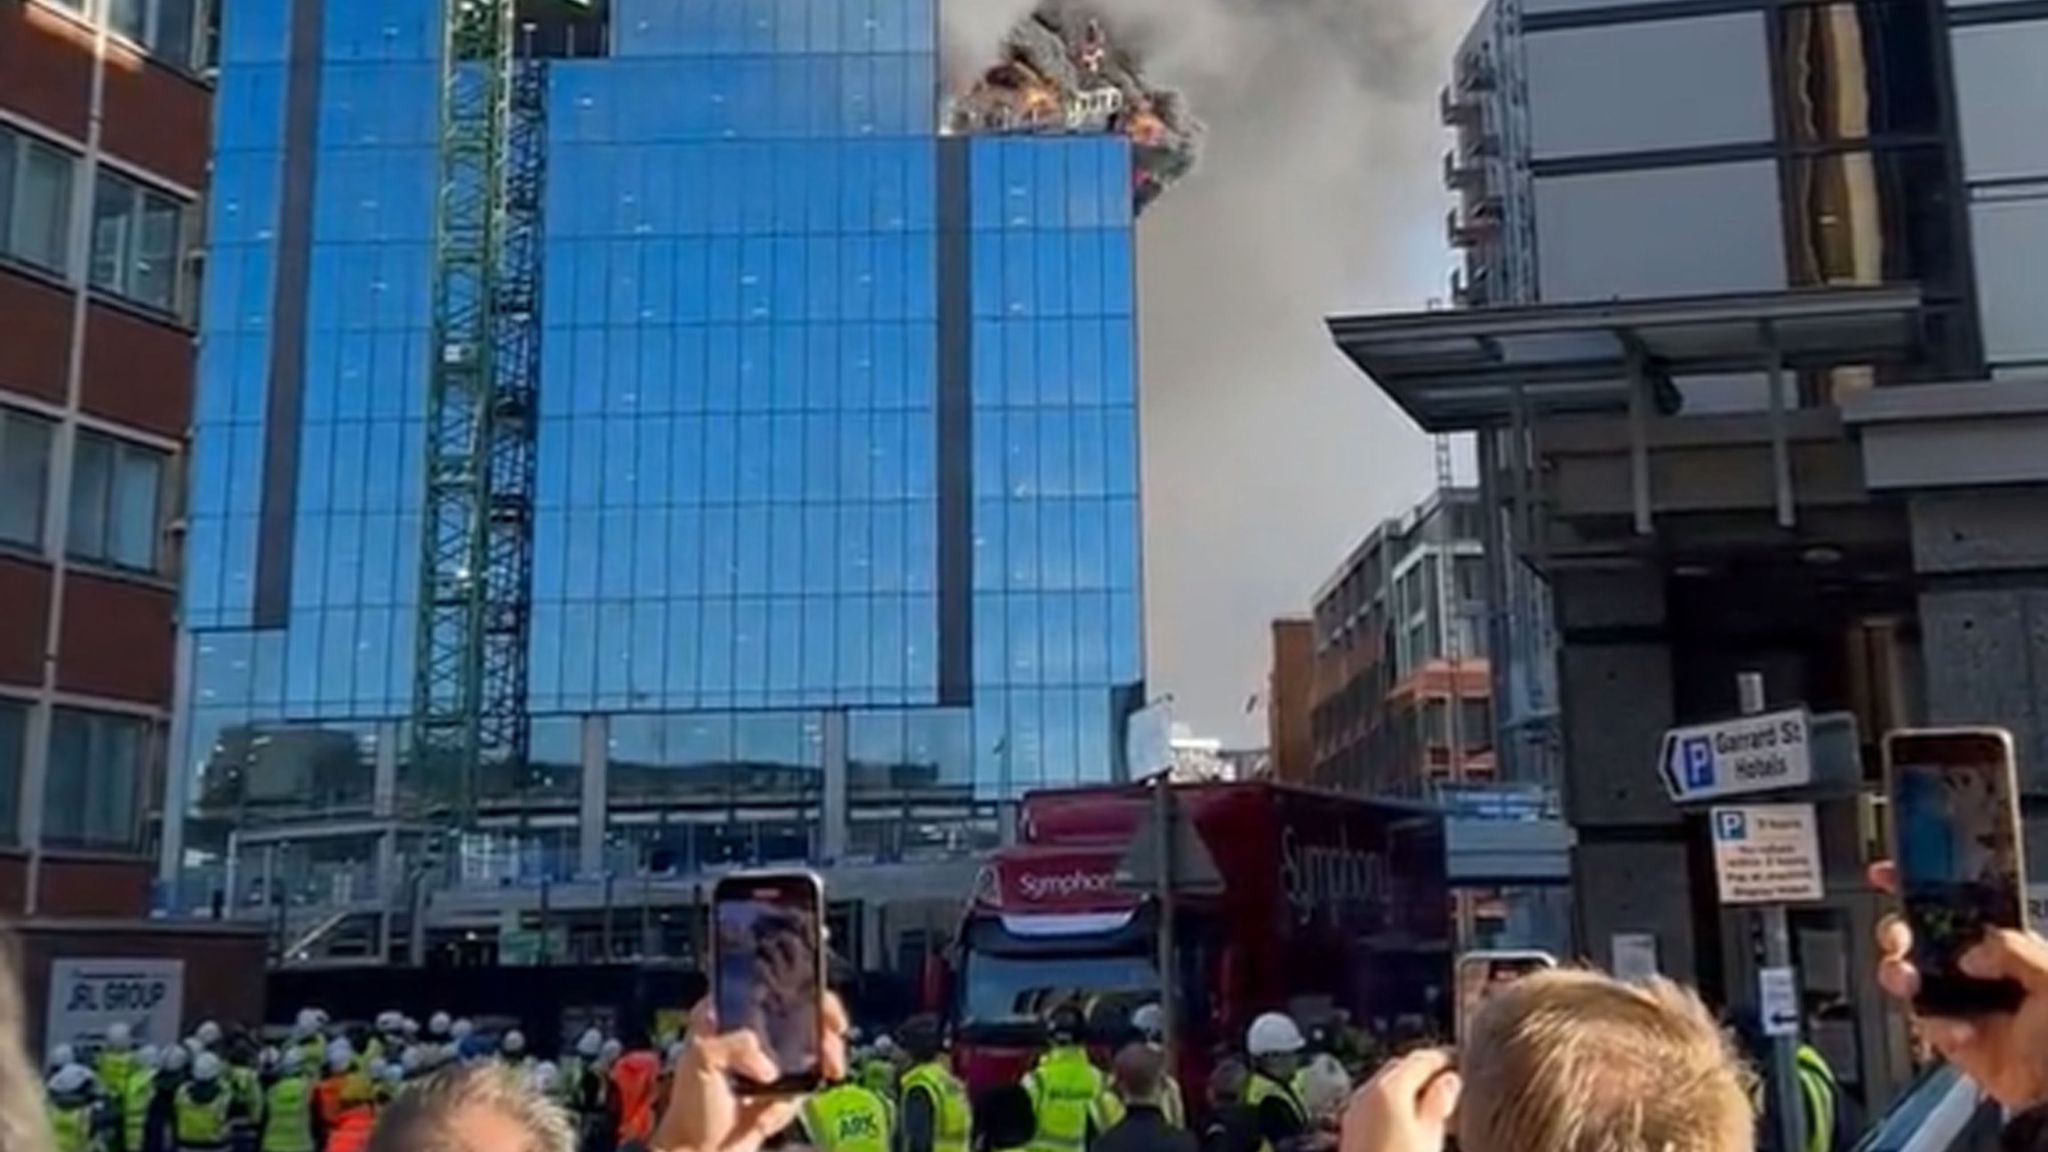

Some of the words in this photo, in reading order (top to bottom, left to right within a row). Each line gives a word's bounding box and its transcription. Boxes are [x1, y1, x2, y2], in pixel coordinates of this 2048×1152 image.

[1716, 724, 1777, 755] Garrard
[1780, 720, 1803, 745] St
[1689, 743, 1709, 784] P
[1735, 753, 1788, 779] Hotels
[1721, 814, 1741, 838] P
[1020, 870, 1115, 900] Symphon
[1279, 818, 1394, 926] Symphony
[103, 980, 166, 1011] GROUP
